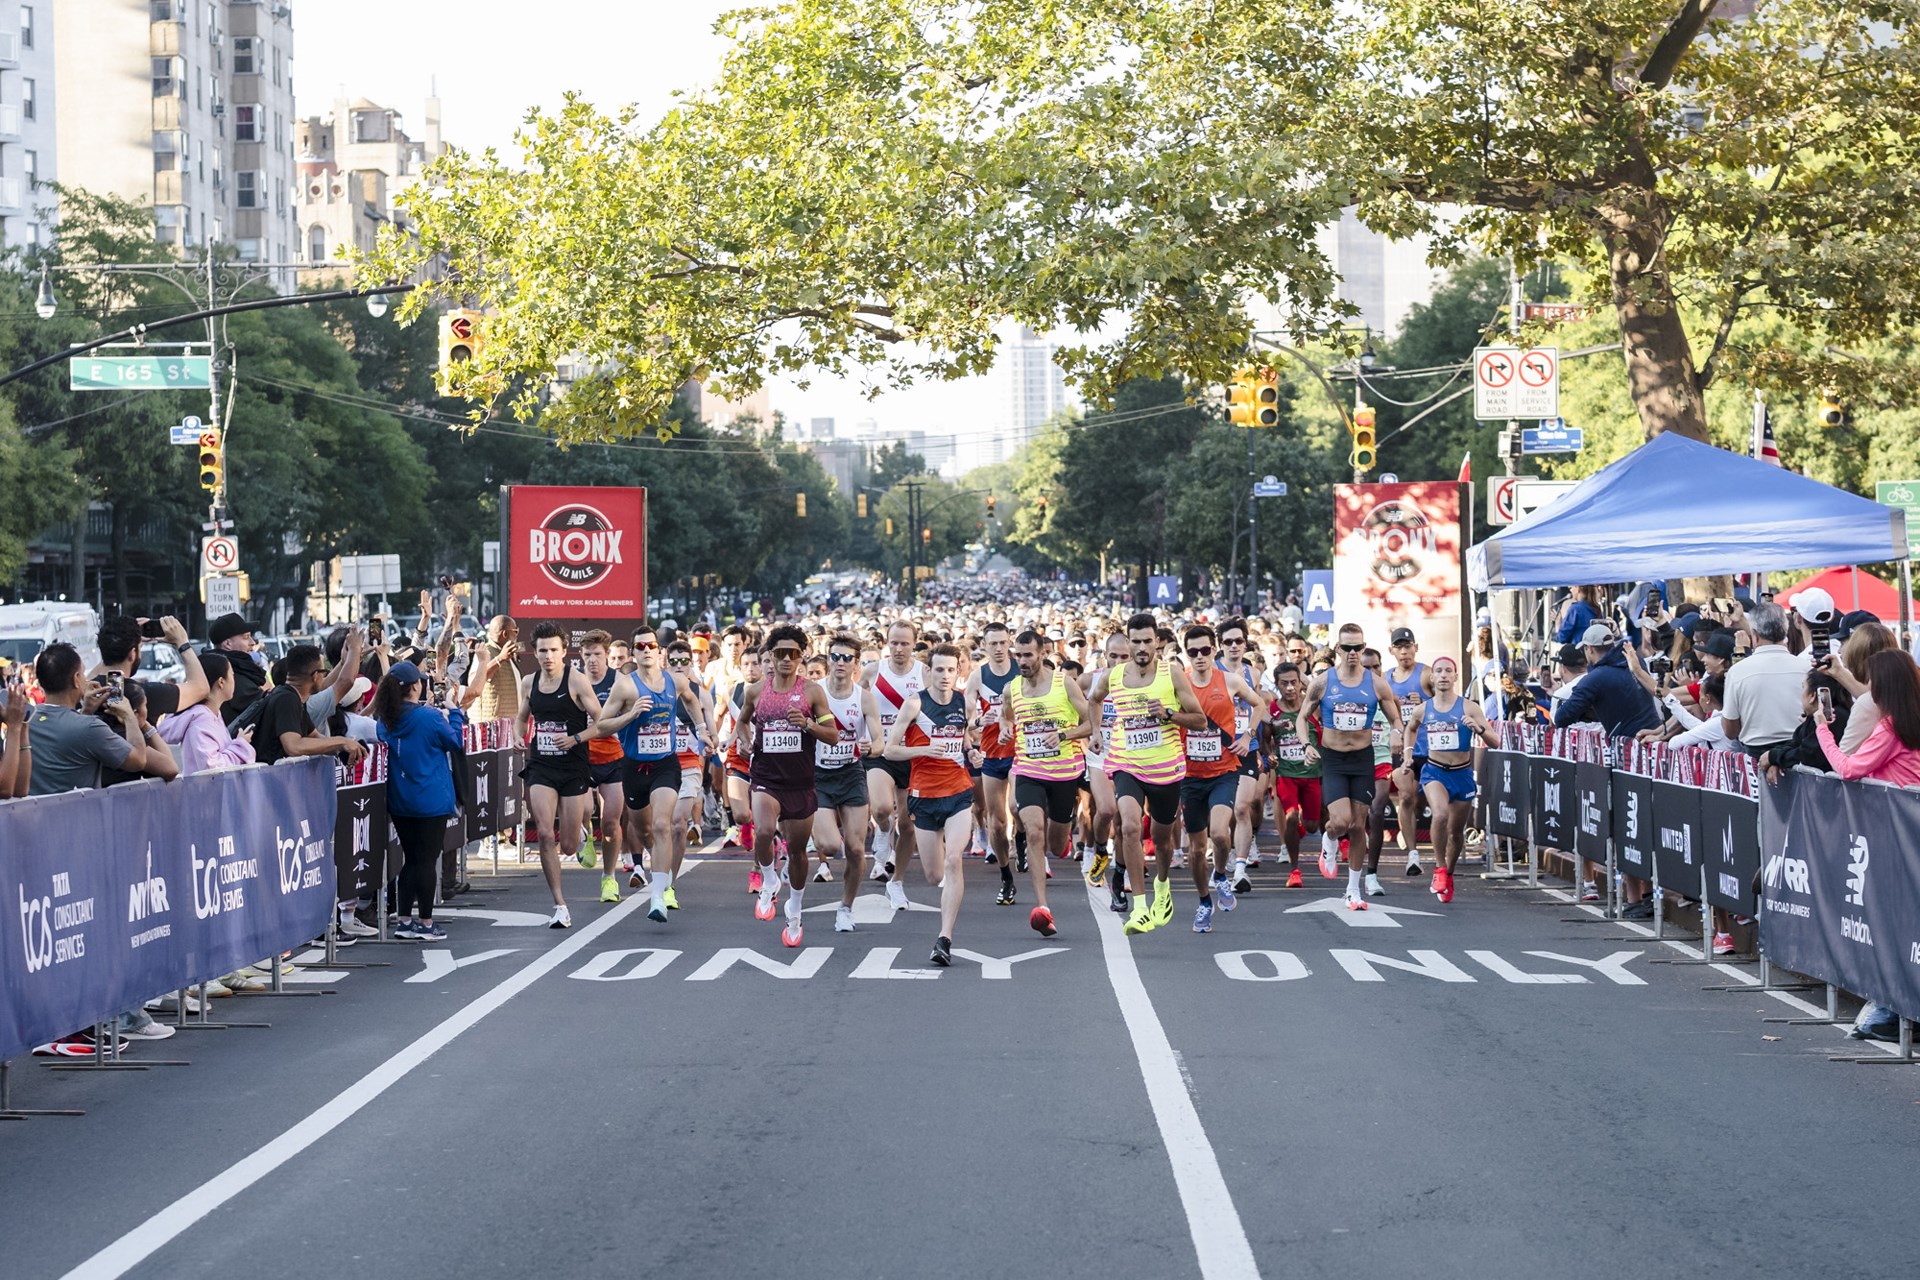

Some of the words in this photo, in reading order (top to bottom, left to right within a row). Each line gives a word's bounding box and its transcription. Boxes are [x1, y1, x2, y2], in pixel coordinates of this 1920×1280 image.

[91, 365, 103, 381] E
[117, 365, 152, 381] 165
[167, 365, 191, 380] St
[530, 529, 622, 564] BRONX
[559, 566, 570, 578] 10
[571, 566, 594, 580] MILE
[213, 583, 232, 592] LEFT
[1157, 582, 1170, 599] A
[213, 594, 233, 602] TURN
[1306, 583, 1334, 612] A
[209, 604, 237, 613] SIGNAL
[1347, 716, 1357, 727] 51
[772, 735, 799, 747] 13400
[1133, 730, 1159, 745] 13907
[1440, 735, 1450, 745] 52
[829, 743, 854, 755] 13112
[1197, 740, 1217, 752] 1626
[1661, 826, 1684, 853] UNITED
[52, 871, 71, 898] TATA
[54, 897, 94, 931] CONSULTANCY
[1774, 900, 1790, 914] ROAD
[19, 882, 53, 974] tcs
[55, 932, 85, 964] SERVICES
[566, 946, 1072, 982] ONLY
[1212, 948, 1650, 985] ONLY
